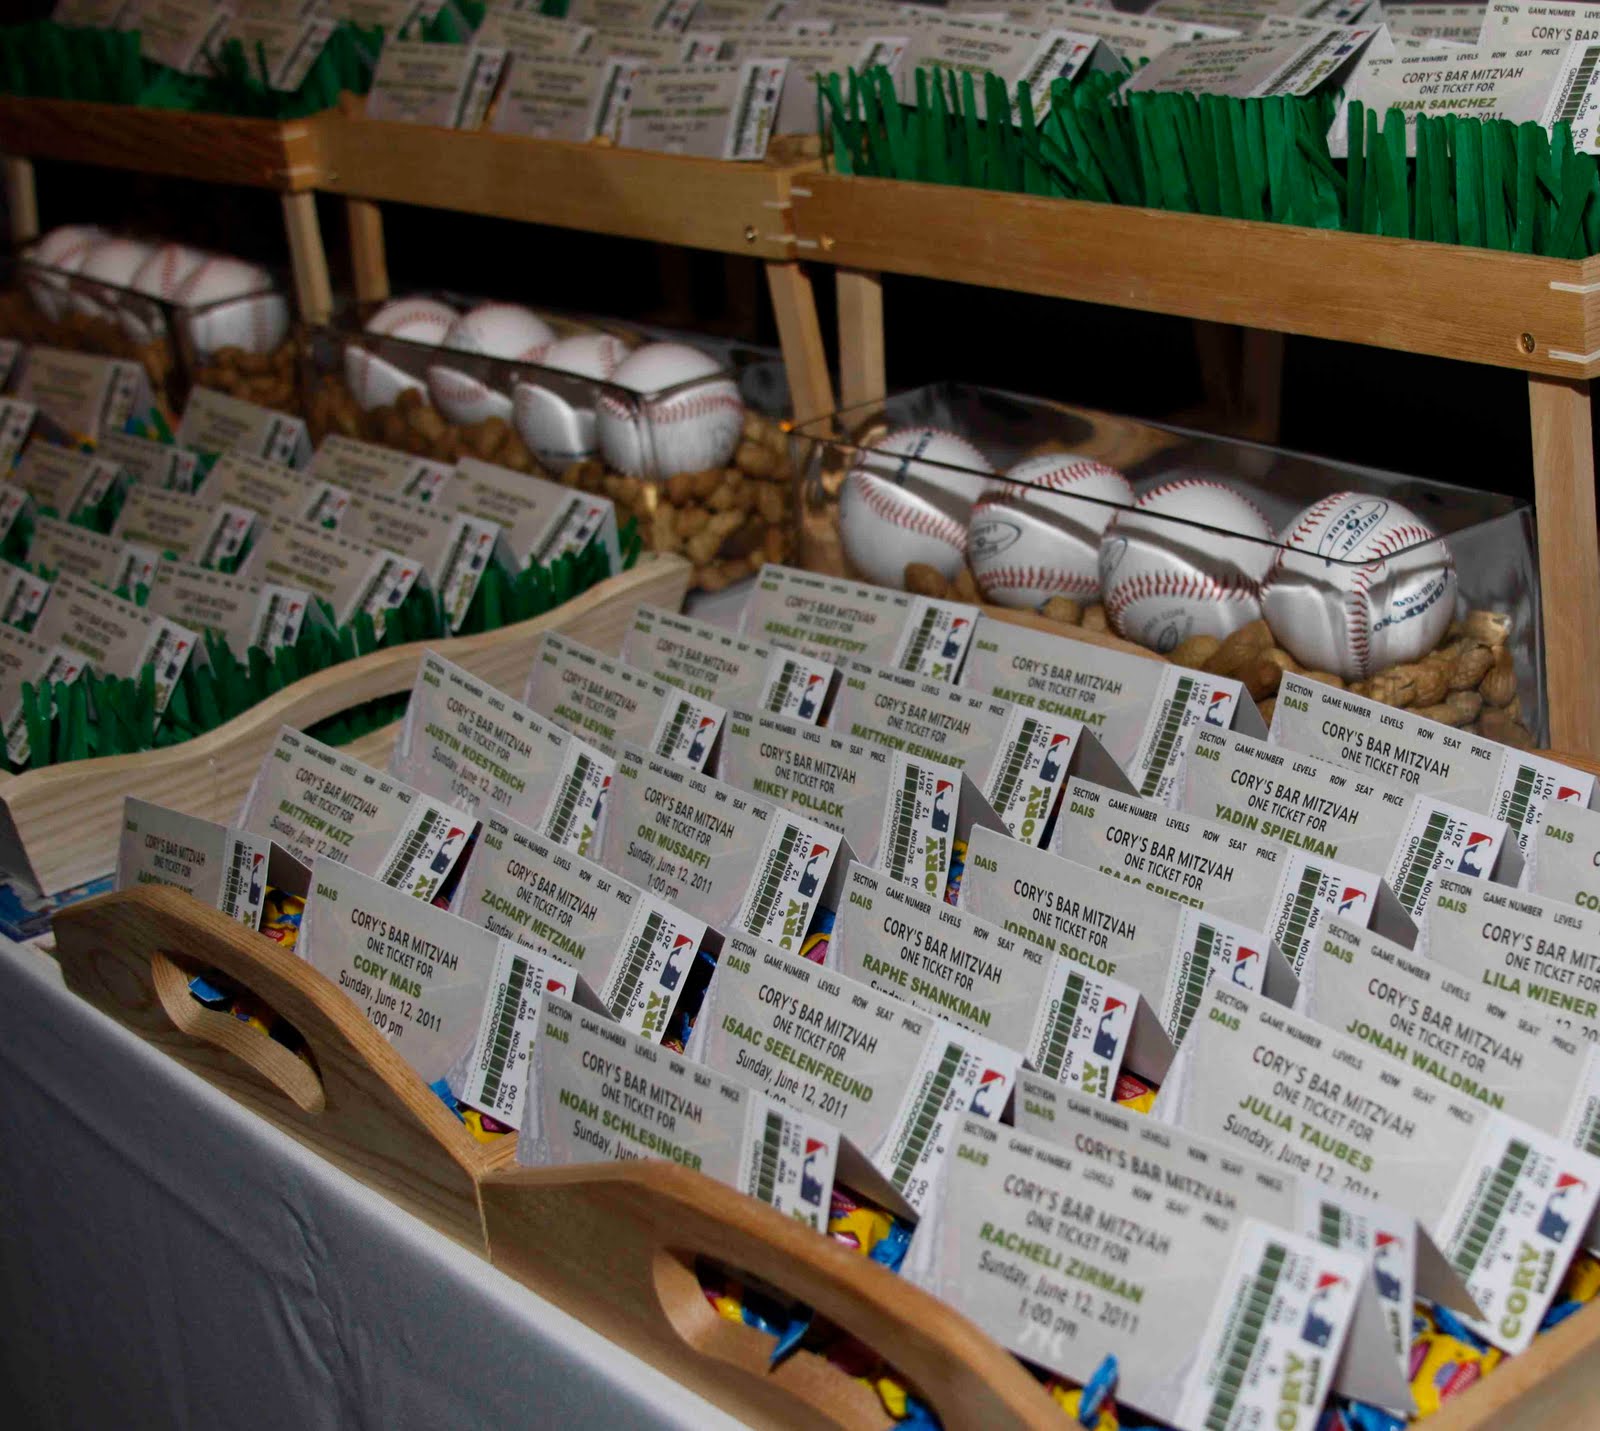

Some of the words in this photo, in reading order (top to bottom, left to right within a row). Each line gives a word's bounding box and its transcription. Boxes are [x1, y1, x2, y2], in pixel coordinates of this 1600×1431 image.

[1494, 5, 1519, 13] SECTION
[1528, 7, 1547, 16] GAME
[1548, 8, 1575, 17] NUMBER
[1532, 27, 1572, 40] CORY'S
[1368, 58, 1393, 66] SECTION
[1402, 54, 1419, 64] GAME
[1402, 71, 1442, 83] CORY'S
[1445, 70, 1470, 80] BAR
[1472, 67, 1524, 80] MITZVAH
[1419, 85, 1440, 94] ONE
[1442, 83, 1473, 94] TICKET
[1476, 82, 1495, 92] FOR
[1429, 97, 1498, 110] SANCHEZ
[1012, 656, 1049, 676] CORY'S
[1050, 666, 1072, 683] BAR
[1073, 672, 1122, 696] MITZVAH
[992, 686, 1036, 710] MAYER
[1038, 699, 1107, 727] SCHARLAT
[1283, 696, 1309, 713] DAIS
[1286, 682, 1313, 698] SECTION
[1322, 695, 1344, 710] GAME
[1343, 702, 1371, 718] NUMBER
[1380, 714, 1404, 730] LEVELS
[1417, 728, 1434, 739] ROW
[1443, 737, 1461, 749] SEAT
[1471, 746, 1491, 760] PRICE
[425, 722, 460, 751] JUSTIN
[461, 743, 526, 793] KOESTERICH
[760, 743, 793, 767] CORY'S
[794, 757, 813, 773] BAR
[814, 762, 857, 784] MITZVAH
[851, 724, 905, 753] MATTHEW
[906, 742, 966, 770] REINHART
[1195, 745, 1221, 762] DAIS
[1322, 721, 1364, 747] CORY'S
[1367, 737, 1393, 756] BAR
[1393, 749, 1450, 778] MITZVAH
[1341, 748, 1363, 765] ONE
[1365, 754, 1399, 776] TICKET
[1400, 770, 1421, 785] FOR
[1199, 731, 1227, 746] SECTION
[1235, 743, 1254, 756] GAME
[1255, 750, 1284, 766] NUMBER
[1292, 762, 1317, 777] LEVELS
[1330, 775, 1347, 786] ROW
[1355, 784, 1374, 796] SEAT
[1383, 793, 1404, 807] PRICE
[644, 787, 675, 813] CORY'S
[674, 801, 694, 821] BAR
[695, 811, 735, 839] MITZVAH
[753, 779, 789, 801] MIKEY
[791, 789, 845, 818] POLLACK
[1070, 802, 1096, 818] DAIS
[1230, 769, 1274, 795] CORY'S
[1274, 784, 1300, 805] BAR
[1302, 796, 1359, 825] MITZVAH
[1247, 795, 1270, 812] ONE
[1271, 803, 1305, 824] TICKET
[1306, 816, 1327, 832] FOR
[279, 800, 324, 833] MATTHEW
[324, 822, 354, 847] KATZ
[655, 812, 673, 828] ONE
[672, 819, 697, 840] TICKET
[696, 831, 712, 846] FOR
[1215, 804, 1260, 831] YADIN
[1260, 821, 1339, 859] SPIELMAN
[627, 842, 656, 868] Sunday,
[657, 858, 676, 877] June
[677, 868, 689, 884] 12,
[690, 874, 713, 894] 2011
[637, 825, 656, 844] ORI
[656, 834, 711, 870] MUSSAFFI
[907, 830, 918, 864] SECTION
[938, 837, 946, 872] MAIS
[974, 854, 998, 873] DAIS
[1106, 826, 1149, 852] CORY'S
[1150, 841, 1176, 861] BAR
[1177, 854, 1235, 882] MITZVAH
[316, 883, 339, 901] DAIS
[506, 860, 539, 887] CORY'S
[538, 877, 558, 898] BAR
[556, 889, 598, 921] MITZVAH
[647, 872, 665, 891] 1:00
[664, 883, 679, 899] pm
[1124, 853, 1146, 870] ONE
[1147, 861, 1182, 882] TICKET
[1182, 874, 1203, 891] FOR
[1326, 877, 1341, 903] 2011
[481, 889, 531, 926] ZACHARY
[531, 919, 587, 960] METZMAN
[1014, 879, 1054, 907] CORY'S
[1056, 896, 1080, 917] BAR
[1081, 907, 1137, 940] MITZVAH
[1032, 908, 1054, 925] ONE
[1055, 916, 1087, 940] TICKET
[1087, 930, 1109, 949] FOR
[351, 908, 387, 936] CORY'S
[388, 927, 410, 948] BAR
[411, 939, 459, 971] MITZVAH
[367, 937, 387, 955] ONE
[387, 945, 416, 970] TICKET
[416, 959, 433, 979] FOR
[662, 923, 676, 950] 2011
[883, 916, 924, 946] CORY'S
[924, 936, 948, 958] BAR
[949, 948, 1003, 984] MITZVAH
[1481, 922, 1533, 953] CORY'S
[1536, 939, 1567, 962] BAR
[354, 955, 388, 982] CORY
[389, 972, 422, 999] MAIS
[1059, 944, 1117, 977] SOCLOF
[339, 970, 374, 1001] Sunday,
[375, 988, 397, 1012] June
[400, 1001, 414, 1022] 12,
[417, 1011, 442, 1033] 2011
[862, 954, 908, 988] RAPHE
[910, 976, 991, 1027] SHANKMAN
[1482, 969, 1521, 995] LILA
[1526, 982, 1599, 1019] WIENER
[365, 1007, 387, 1029] 1:00
[387, 1020, 404, 1037] pm
[758, 984, 799, 1016] CORY'S
[799, 1004, 824, 1028] BAR
[824, 1018, 879, 1055] MITZVAH
[721, 1014, 763, 1046] ISAAC
[763, 1036, 874, 1103] SEELENFREUND
[1346, 1019, 1409, 1060] JONAH
[1411, 1048, 1506, 1110] WALDMAN
[736, 1050, 774, 1081] Sunday,
[774, 1069, 799, 1095] June
[800, 1084, 817, 1104] 12,
[817, 1093, 849, 1119] 2011
[1252, 1045, 1306, 1084] CORY'S
[1308, 1074, 1342, 1100] BAR
[1344, 1089, 1416, 1137] MITZVAH
[560, 1088, 600, 1121] NOAH
[602, 1110, 702, 1170] SCHLESINGER
[1239, 1094, 1295, 1132] JULIA
[1299, 1122, 1375, 1173] TAUBES
[979, 1222, 1062, 1274] RACHELI
[1065, 1259, 1146, 1303] ZIRMAN
